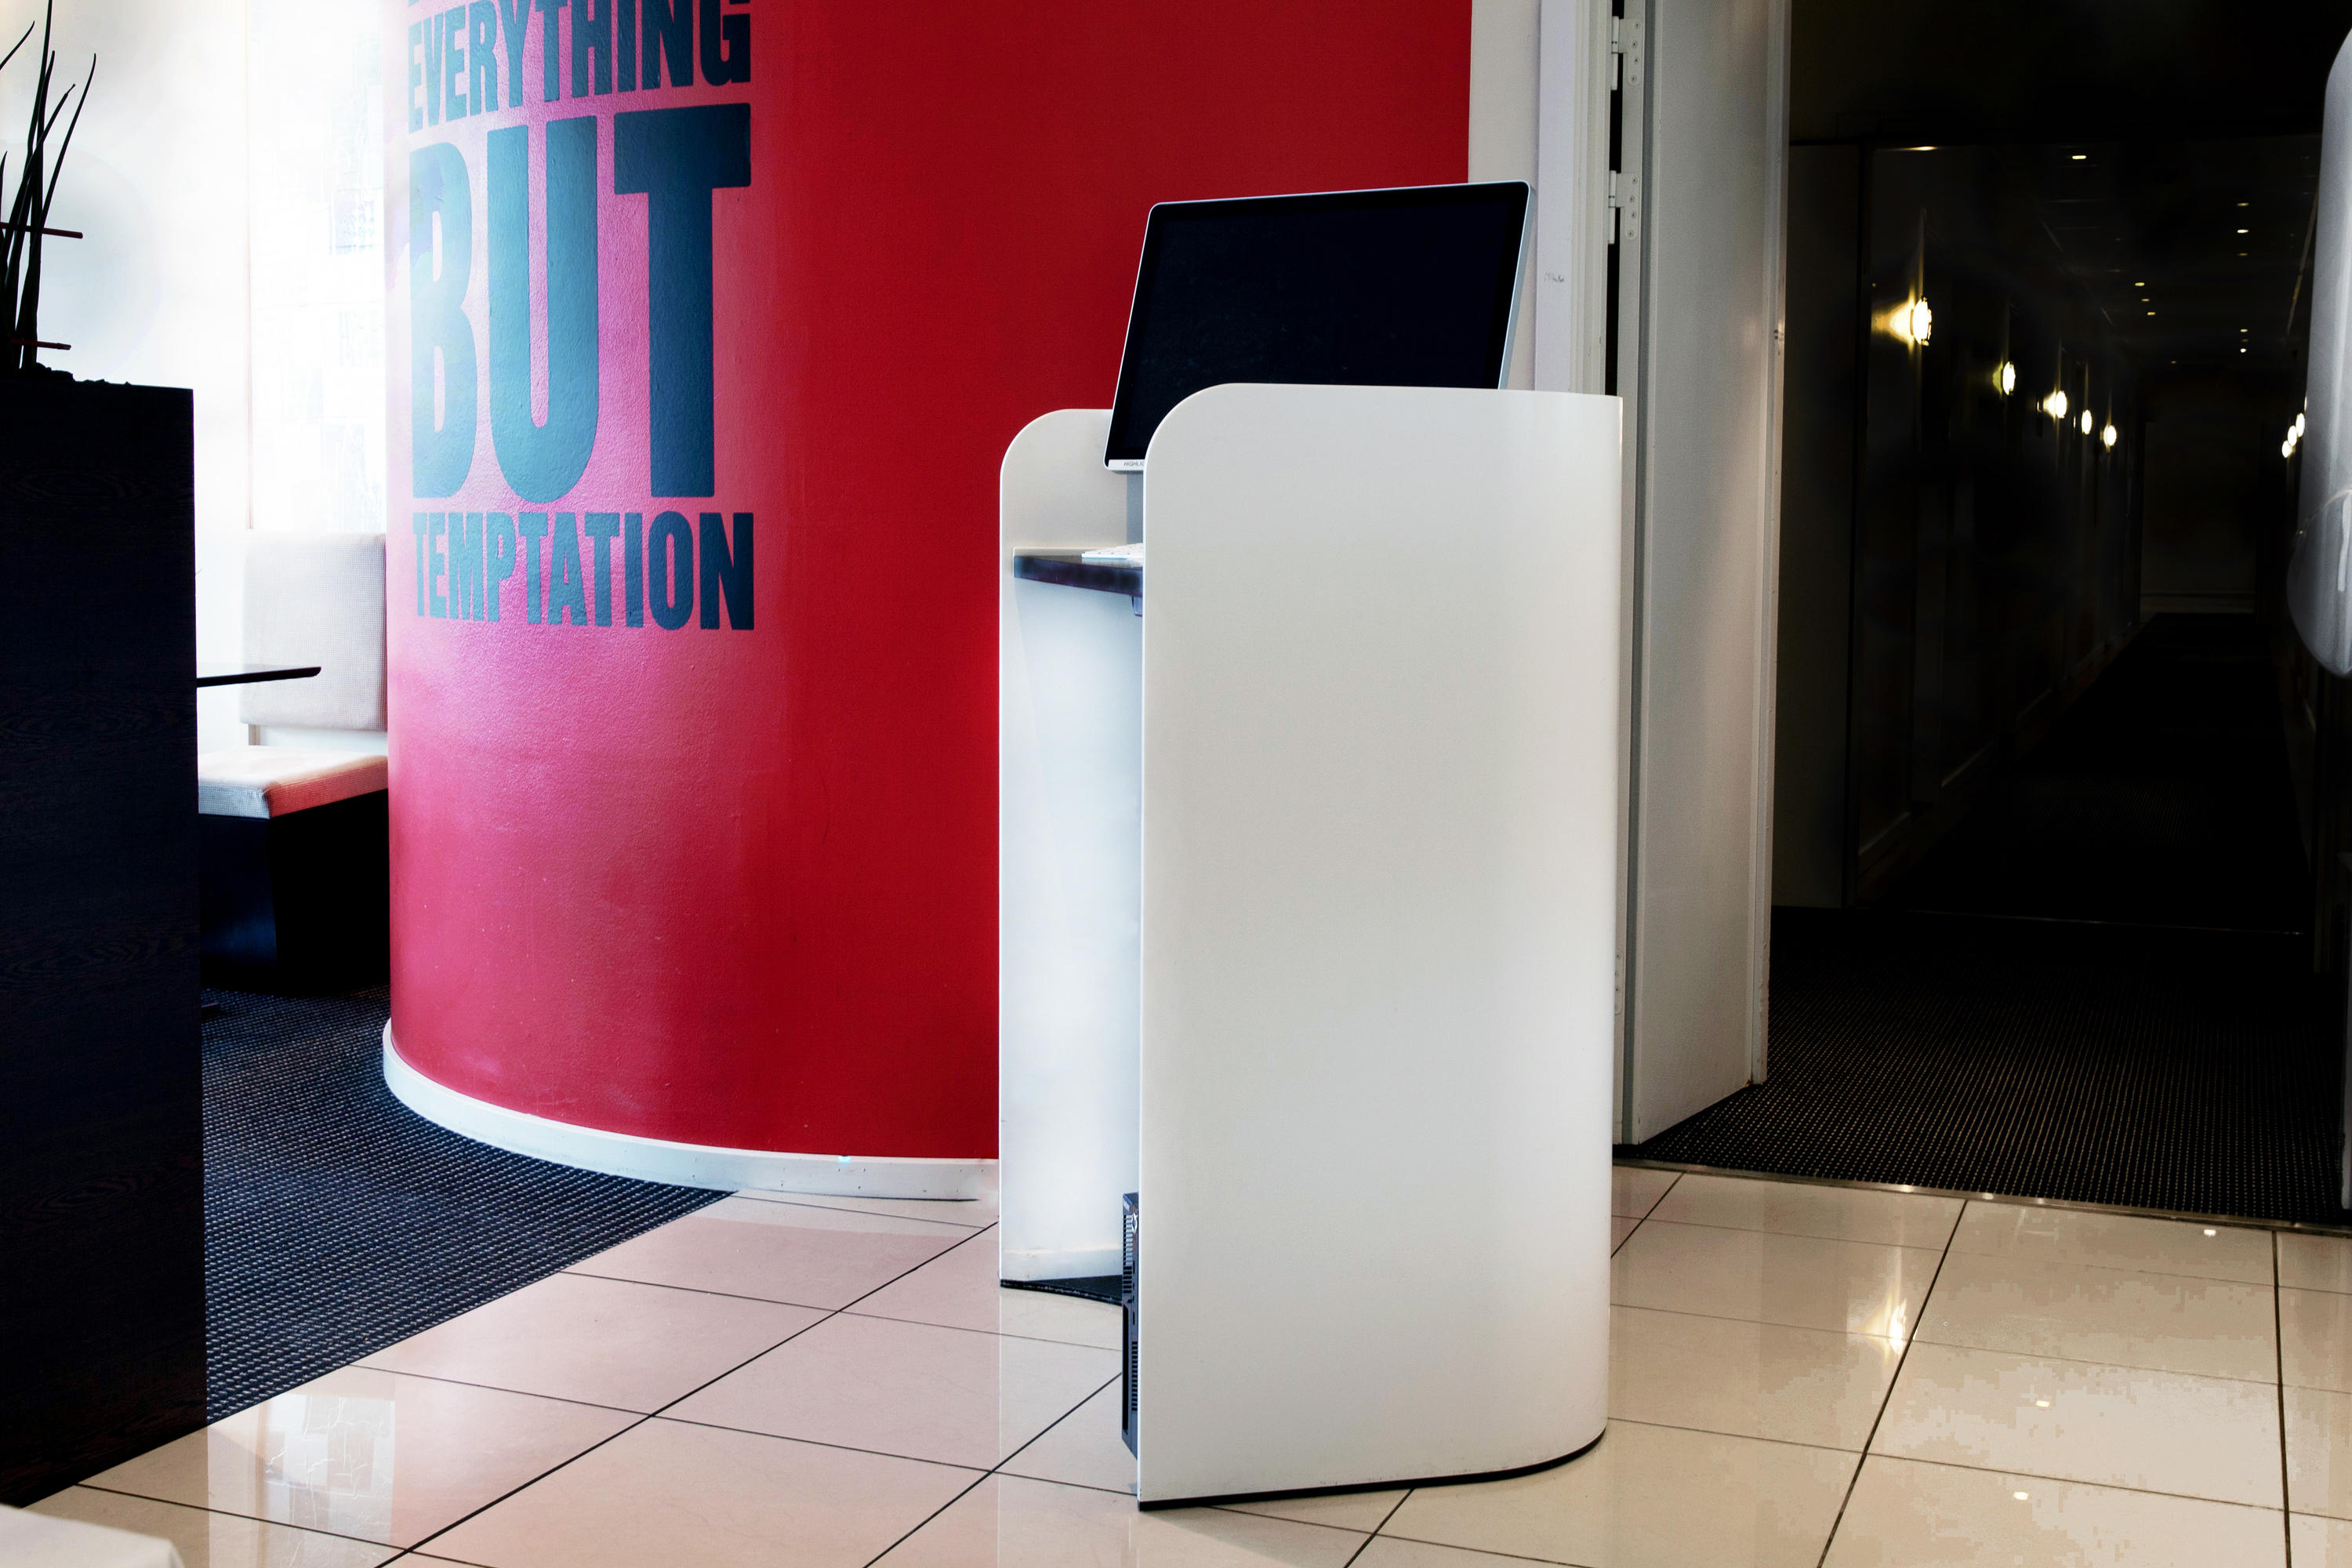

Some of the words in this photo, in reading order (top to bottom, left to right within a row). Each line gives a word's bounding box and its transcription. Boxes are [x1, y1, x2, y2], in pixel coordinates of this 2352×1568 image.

[408, 0, 751, 134] EVERYTHING
[409, 103, 751, 504] BUT
[412, 510, 754, 630] TEMPTATION
